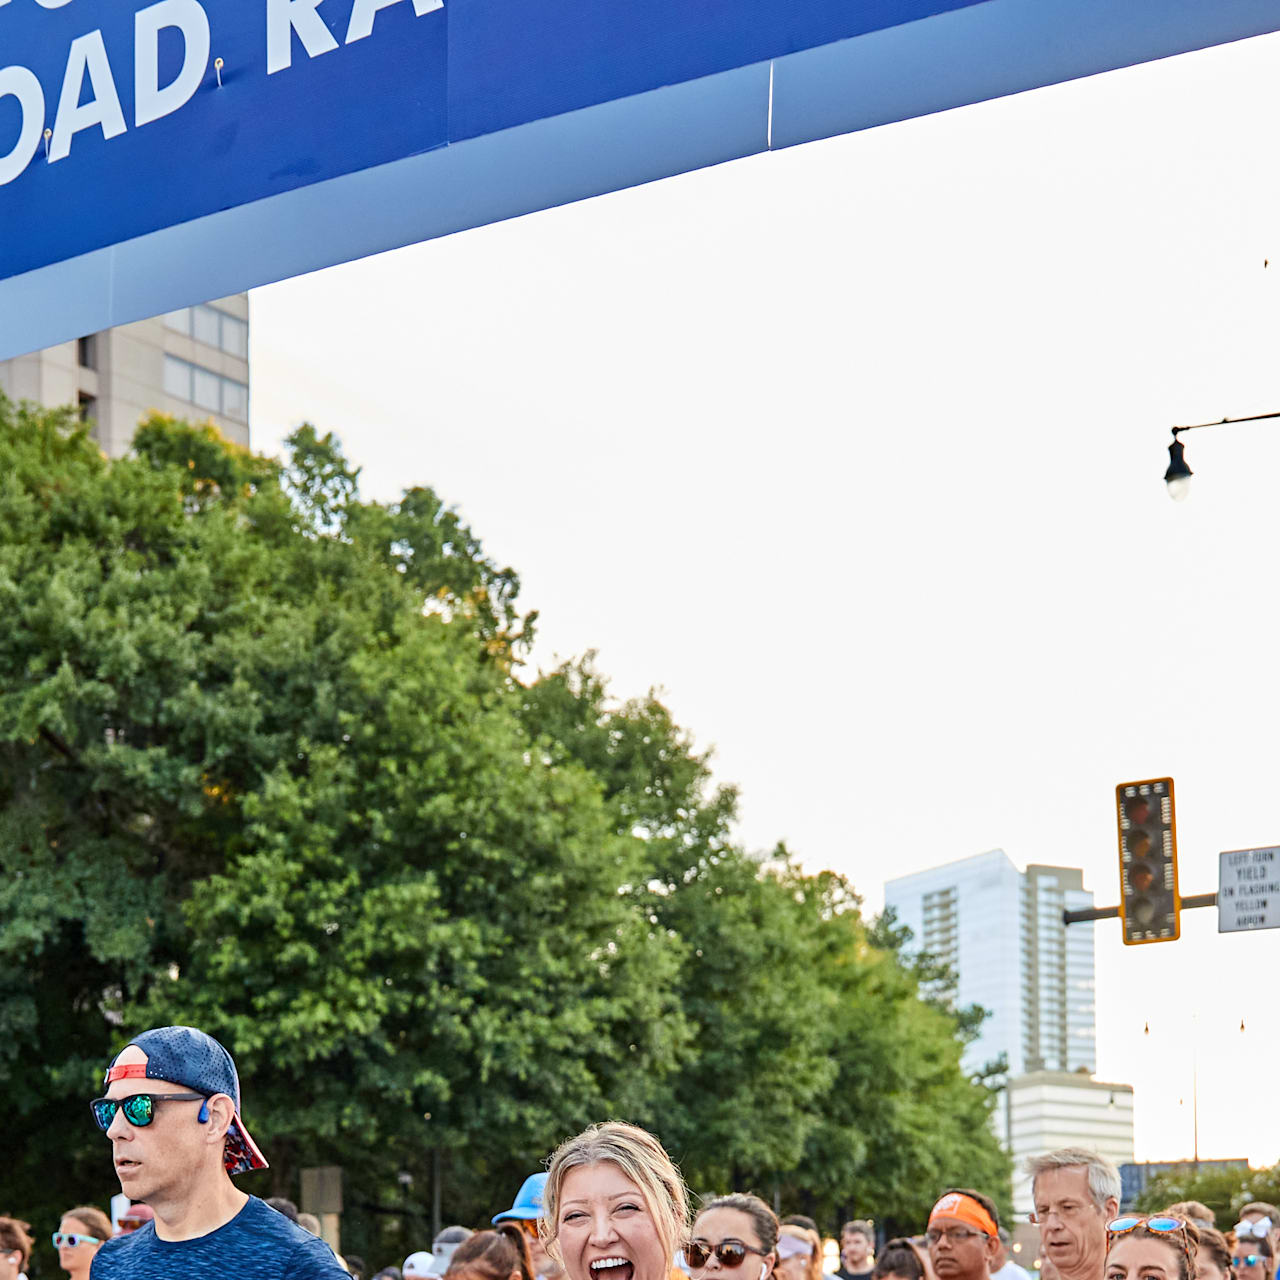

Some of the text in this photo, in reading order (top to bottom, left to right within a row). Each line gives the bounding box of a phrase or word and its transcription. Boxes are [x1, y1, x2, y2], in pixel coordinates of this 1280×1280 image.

[1229, 851, 1275, 867] LEFT TURN
[1236, 866, 1267, 880] YIELD
[1238, 882, 1280, 895] FLASHING
[1234, 900, 1268, 912] YELLOW
[1236, 914, 1266, 927] ARROW
